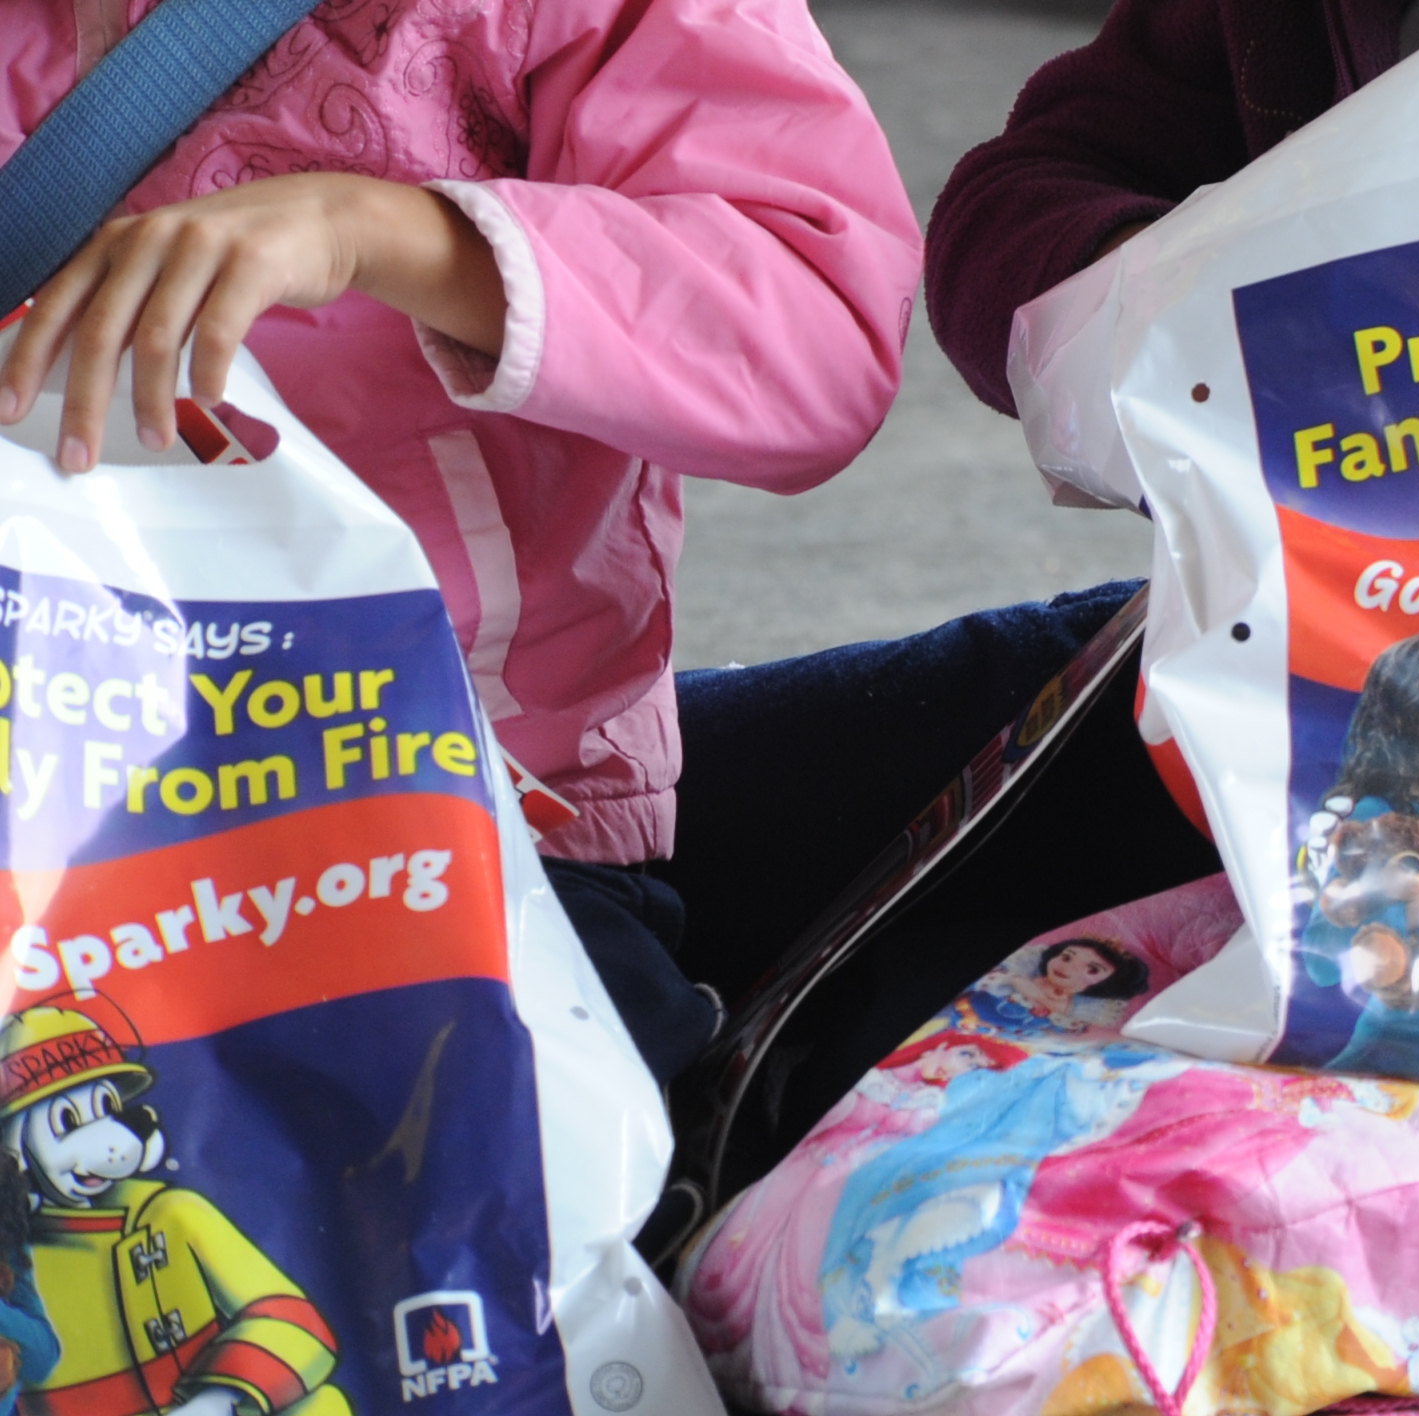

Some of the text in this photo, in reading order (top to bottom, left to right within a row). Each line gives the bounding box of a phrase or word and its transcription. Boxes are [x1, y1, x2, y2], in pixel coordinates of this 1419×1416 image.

[189, 669, 394, 736] Your
[83, 740, 297, 816] From
[323, 717, 477, 790] Fire
[10, 849, 452, 1003] Sparky.org
[402, 1360, 498, 1402] NFPA
